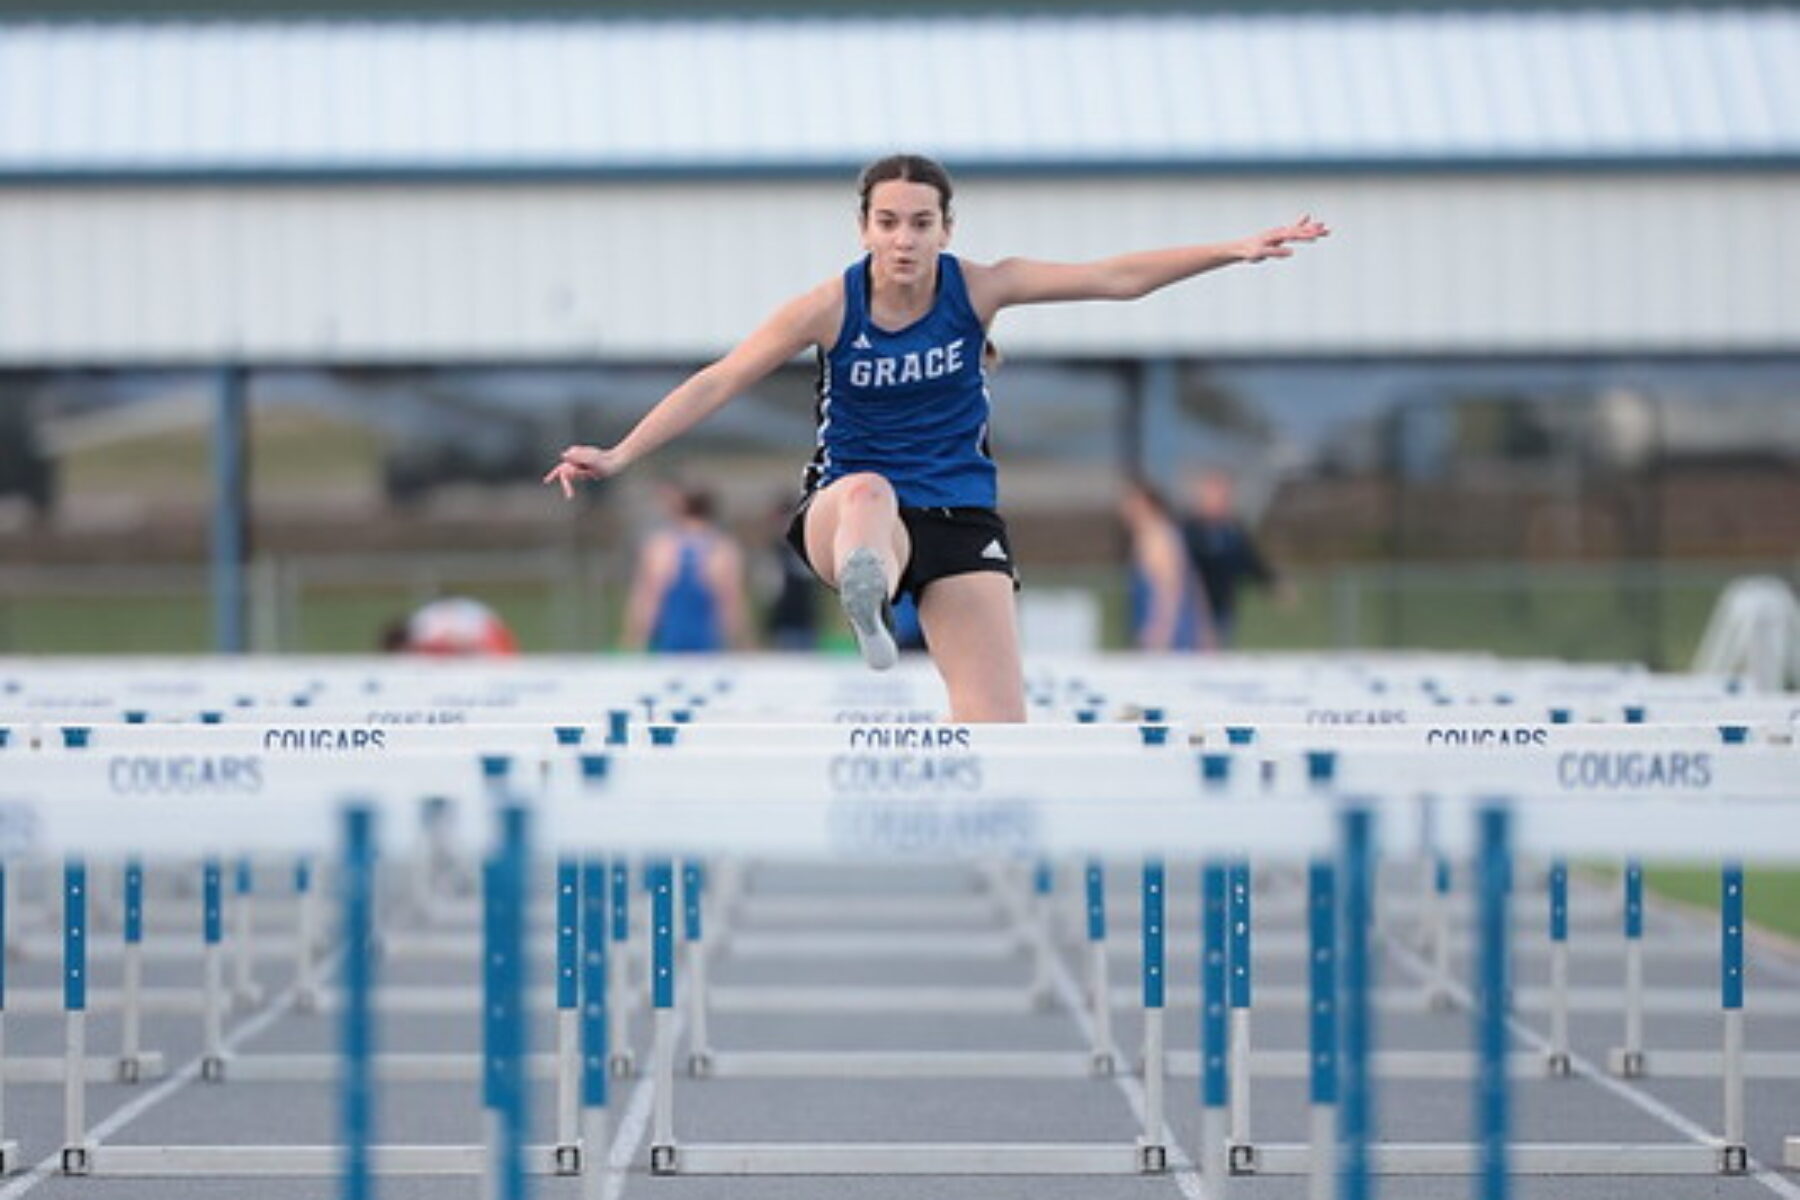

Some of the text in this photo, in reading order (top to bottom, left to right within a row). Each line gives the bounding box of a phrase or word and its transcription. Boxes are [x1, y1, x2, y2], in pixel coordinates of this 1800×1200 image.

[851, 339, 965, 387] GRACE
[265, 729, 386, 748] COUGARS
[850, 728, 971, 748] COUGARS
[109, 756, 264, 794] COUGARS
[1557, 751, 1712, 789] COUGARS
